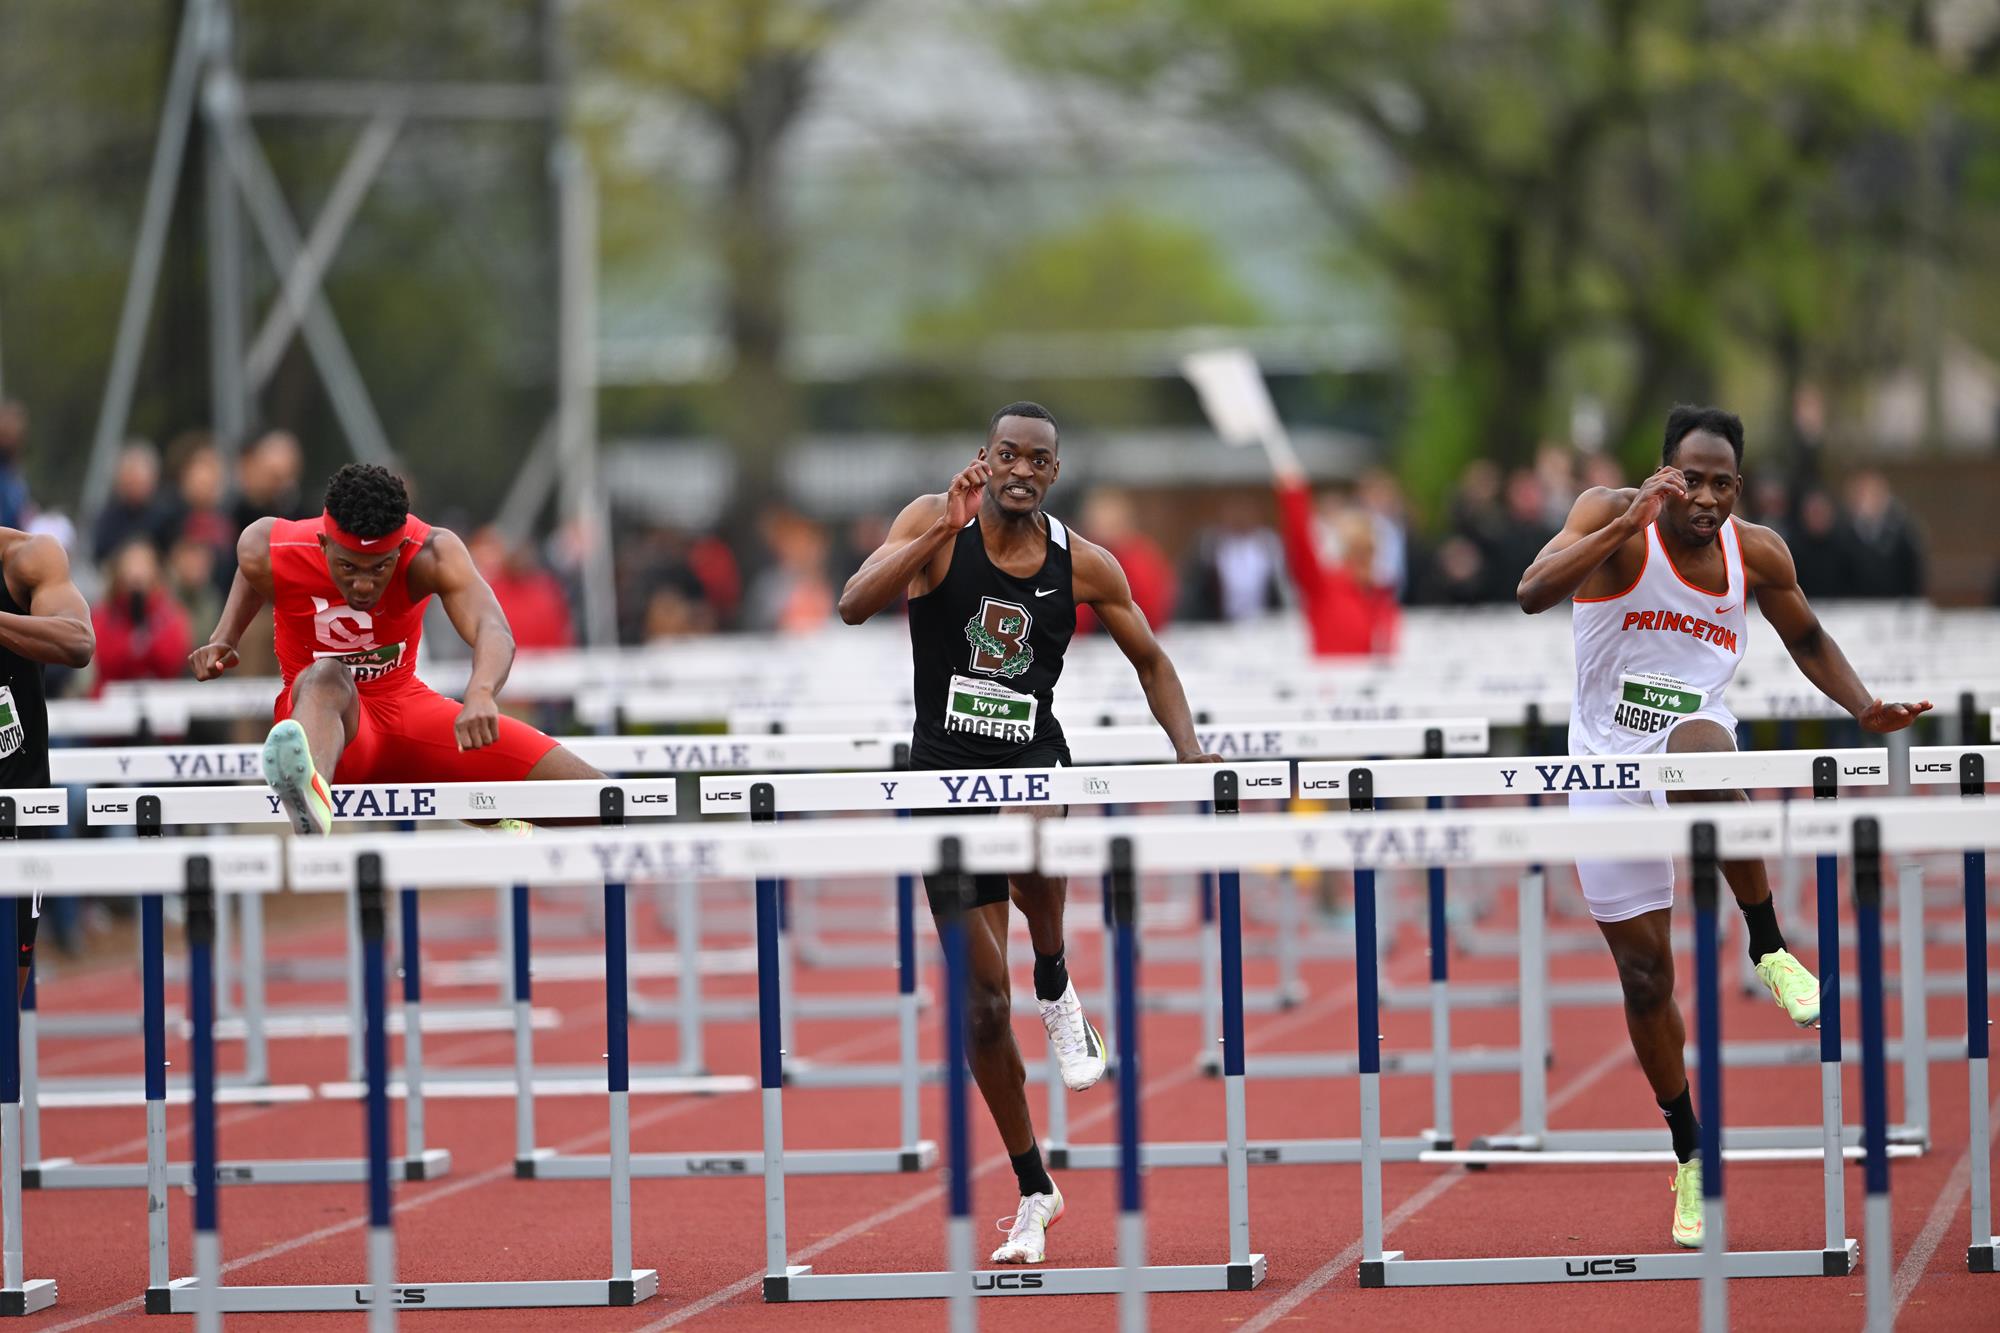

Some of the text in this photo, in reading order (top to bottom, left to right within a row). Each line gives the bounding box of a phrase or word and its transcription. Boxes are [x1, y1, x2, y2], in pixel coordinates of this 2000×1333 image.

[1622, 610, 1737, 654] PRINCETON
[349, 659, 399, 682] RTIN
[1643, 688, 1668, 707] Ivy
[972, 698, 998, 716] Ivy
[947, 714, 1031, 744] ROGERS
[1199, 732, 1282, 756] YALE
[169, 753, 258, 777] YALE
[664, 744, 750, 769] YALE
[1500, 763, 1641, 791] Y YALE
[1664, 769, 1685, 779] IVY
[1844, 766, 1881, 775] UCS
[1915, 764, 1952, 773] UCS
[880, 773, 1050, 803] Y YALE
[1089, 780, 1110, 790] IVY
[1246, 777, 1283, 787] UCS
[1304, 780, 1340, 789] UCS
[331, 788, 436, 817] YALE
[475, 795, 496, 805] IVY
[632, 794, 669, 803] UCS
[706, 792, 743, 800] UCS
[23, 805, 60, 814] UCS
[92, 804, 129, 813] UCS
[686, 1158, 747, 1174] UCS
[1566, 1257, 1637, 1276] UCS
[972, 1273, 1043, 1290] UCS
